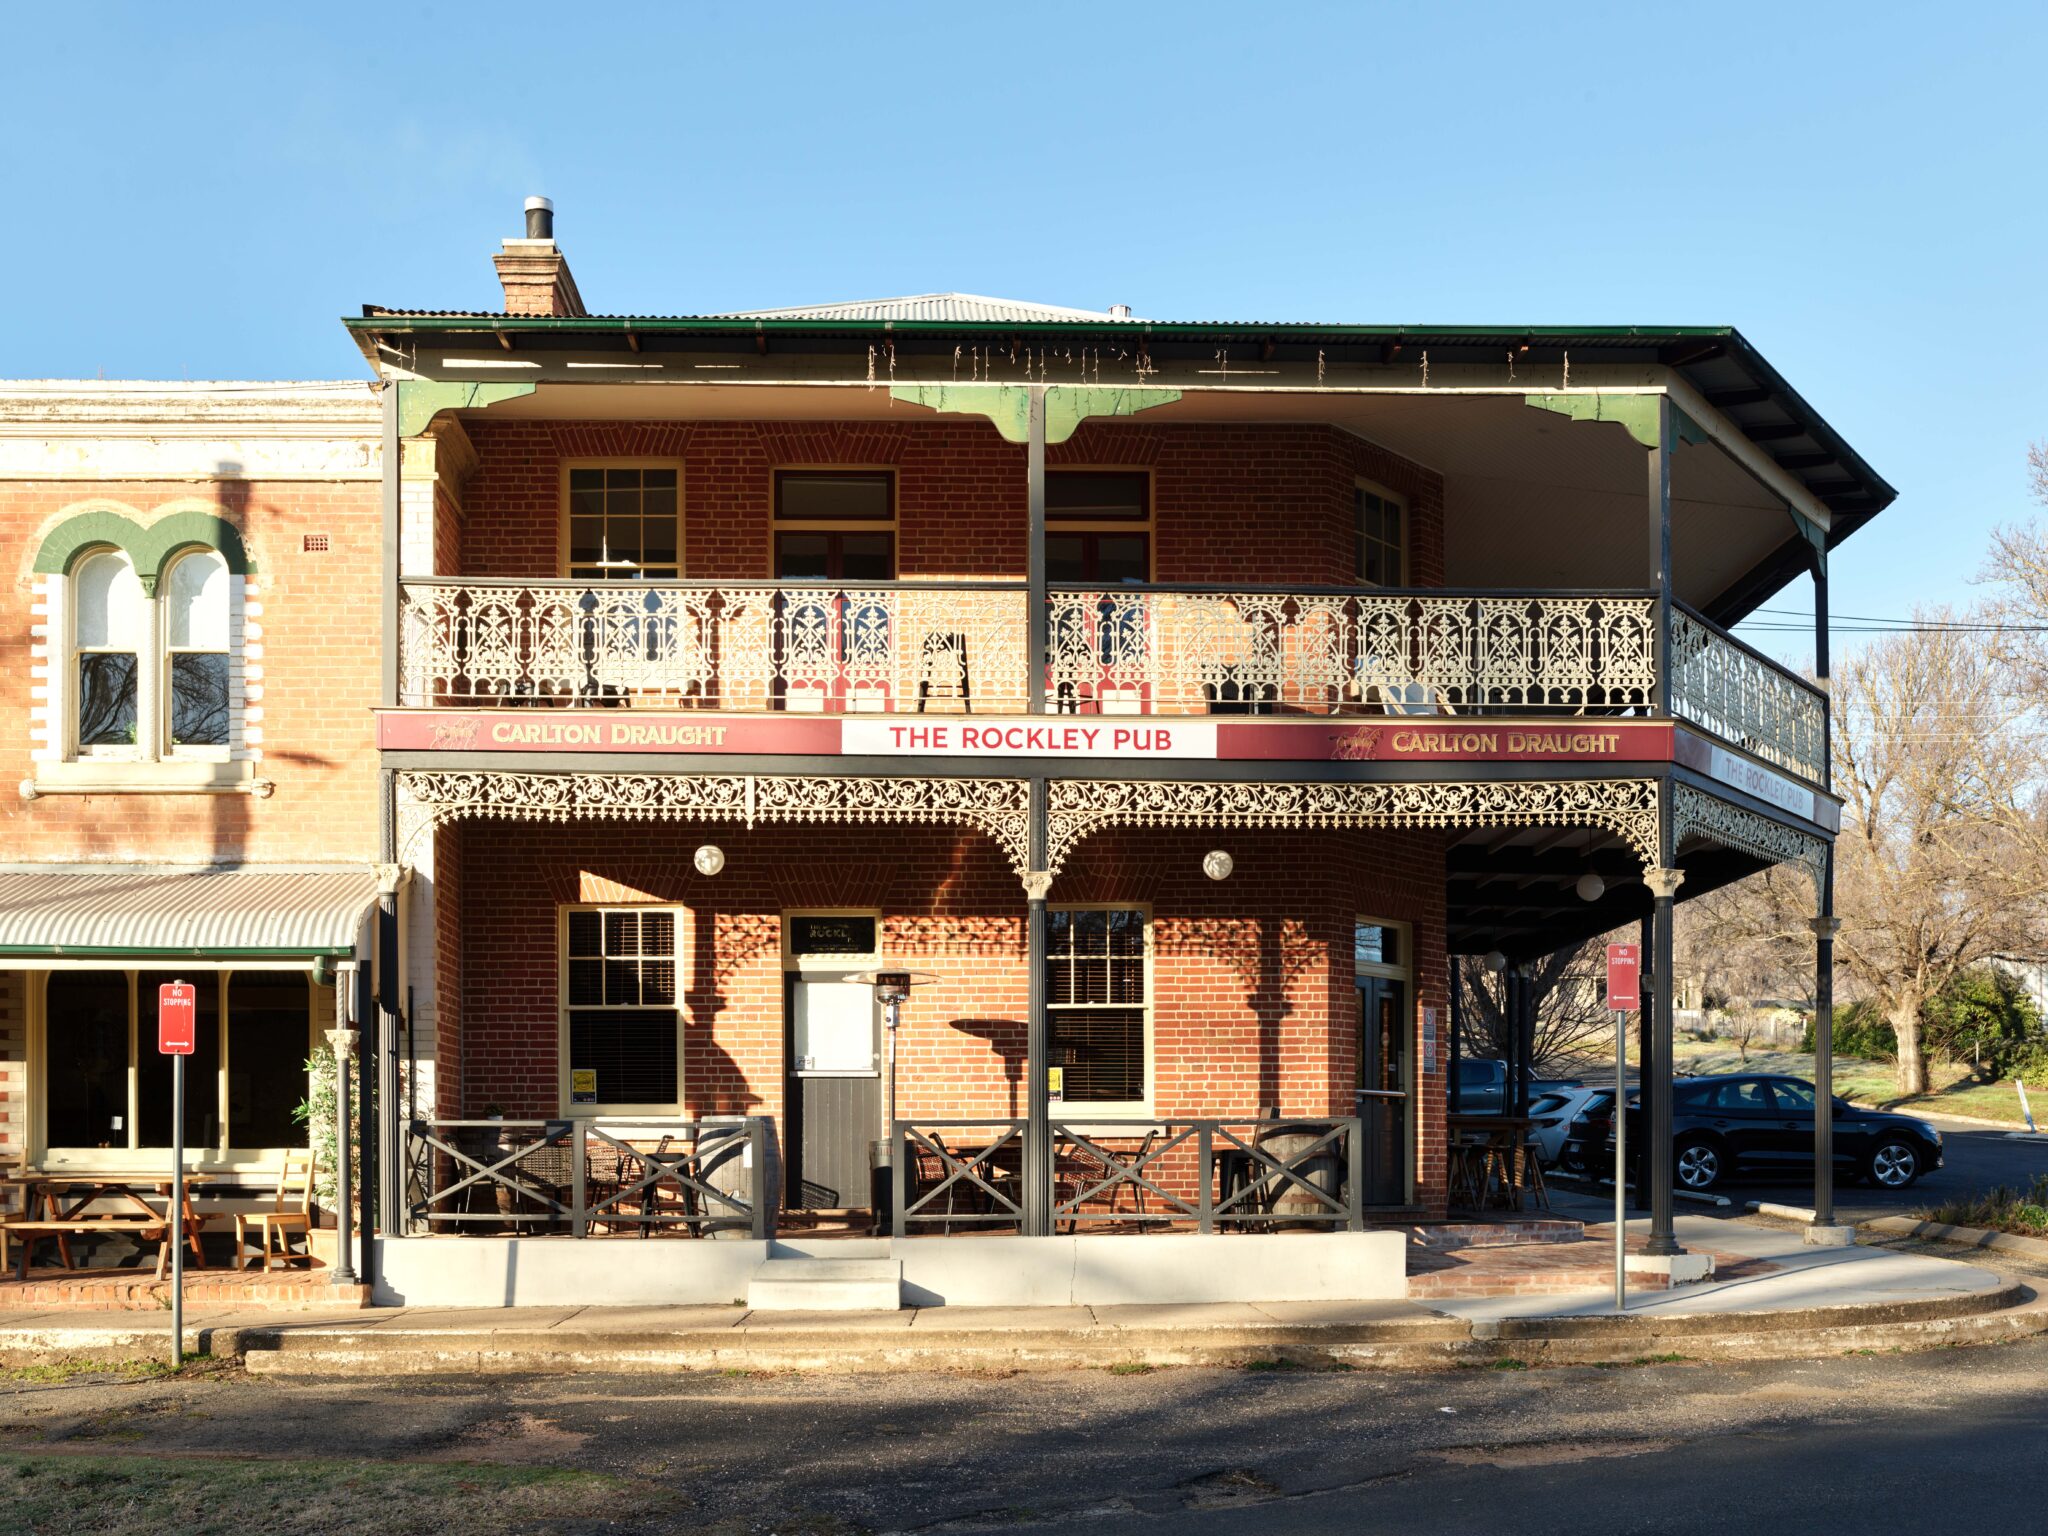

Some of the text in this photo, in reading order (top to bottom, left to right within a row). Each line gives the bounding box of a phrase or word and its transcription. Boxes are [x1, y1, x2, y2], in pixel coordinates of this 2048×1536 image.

[491, 722, 727, 746] CARLTON DRAUGHT
[889, 727, 1172, 751] THE ROCKLEY PUB
[1391, 733, 1620, 753] CARLTON DRAUGHT
[1726, 758, 1804, 810] THE ROCKLEY PUB
[163, 998, 191, 1006] STOPPING
[172, 989, 183, 997] NO
